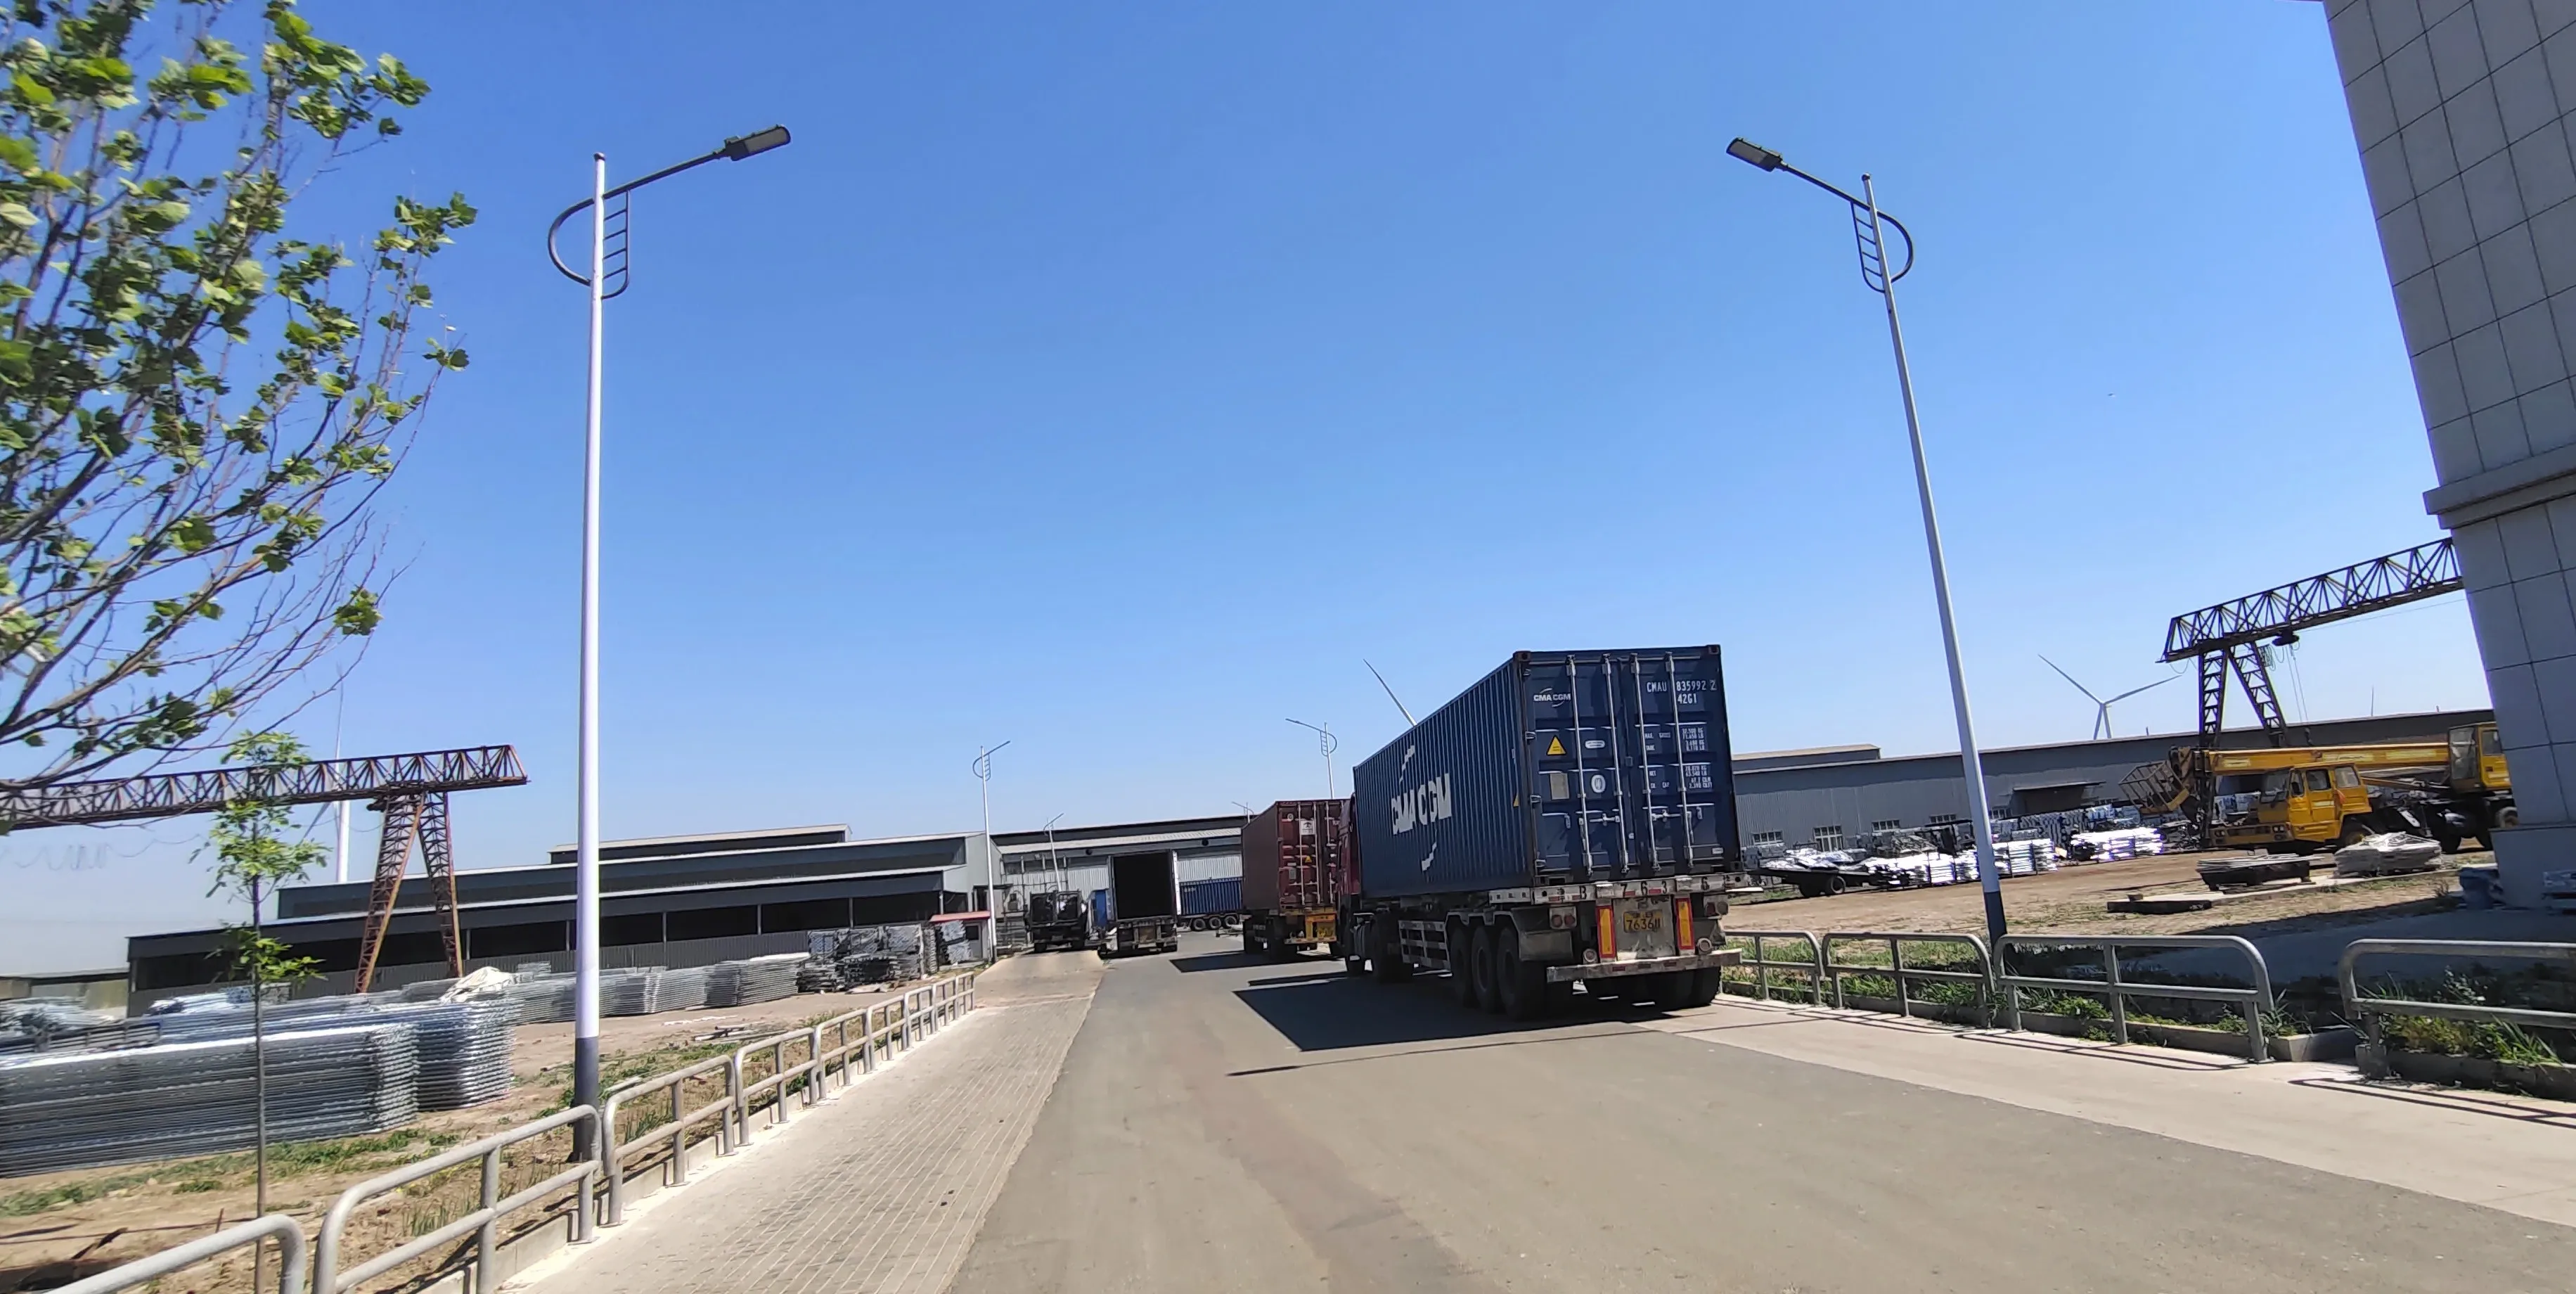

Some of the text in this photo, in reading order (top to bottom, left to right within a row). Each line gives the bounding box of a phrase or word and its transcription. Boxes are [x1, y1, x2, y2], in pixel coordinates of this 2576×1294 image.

[1647, 681, 1667, 693] CMAU
[1676, 680, 1706, 692] 835992
[1677, 693, 1697, 704] 42G1
